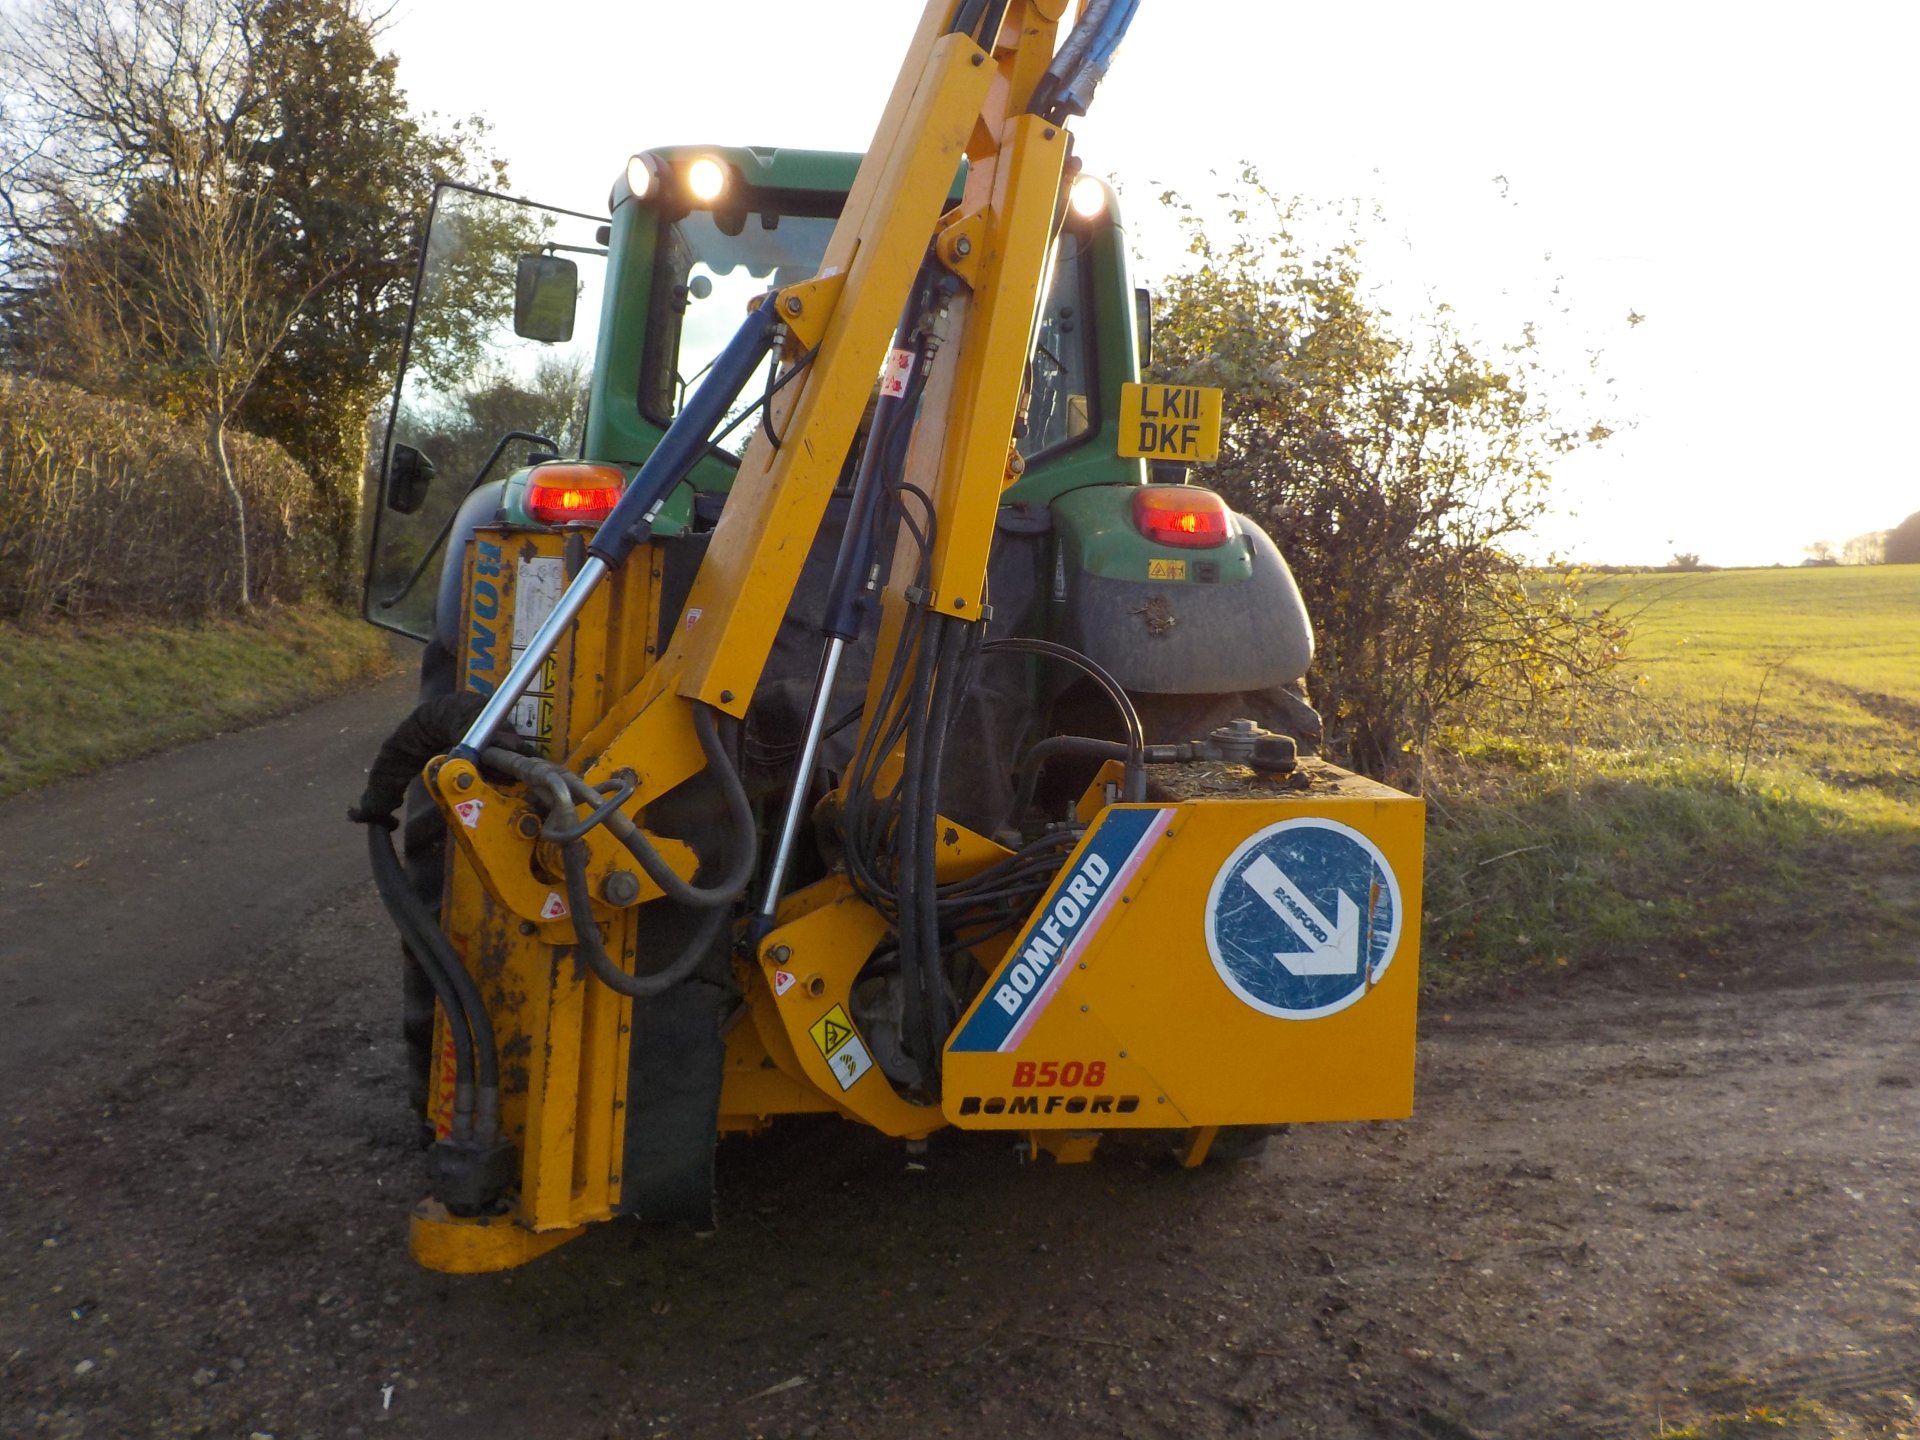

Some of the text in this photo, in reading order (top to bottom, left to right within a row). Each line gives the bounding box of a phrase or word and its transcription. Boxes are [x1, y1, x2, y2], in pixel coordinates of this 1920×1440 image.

[1138, 422, 1200, 454] DKF
[1273, 886, 1328, 943] BOMFORD
[993, 853, 1110, 1016] BOMFORD
[1012, 1061, 1107, 1088] B508
[959, 1095, 1140, 1116] BOMFORD
